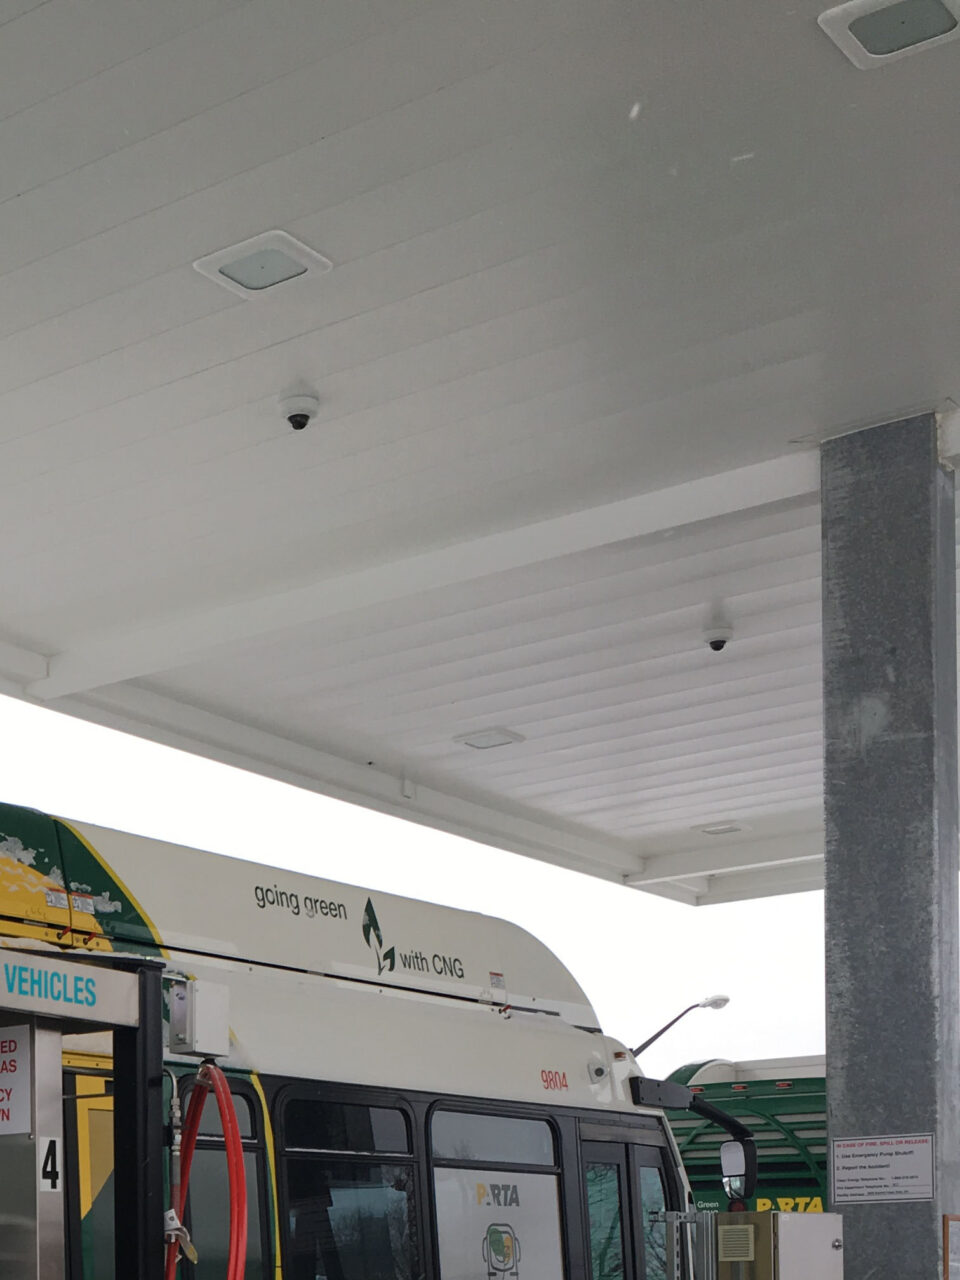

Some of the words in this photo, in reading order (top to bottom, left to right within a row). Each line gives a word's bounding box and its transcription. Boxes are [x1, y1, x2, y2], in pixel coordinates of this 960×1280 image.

[254, 884, 300, 915] going
[304, 896, 347, 919] green
[400, 950, 429, 972] with
[433, 954, 464, 979] CNG
[4, 963, 97, 1007] VEHICLES
[541, 1069, 568, 1091] 9804
[43, 1139, 59, 1190] 4
[697, 1201, 719, 1209] Green
